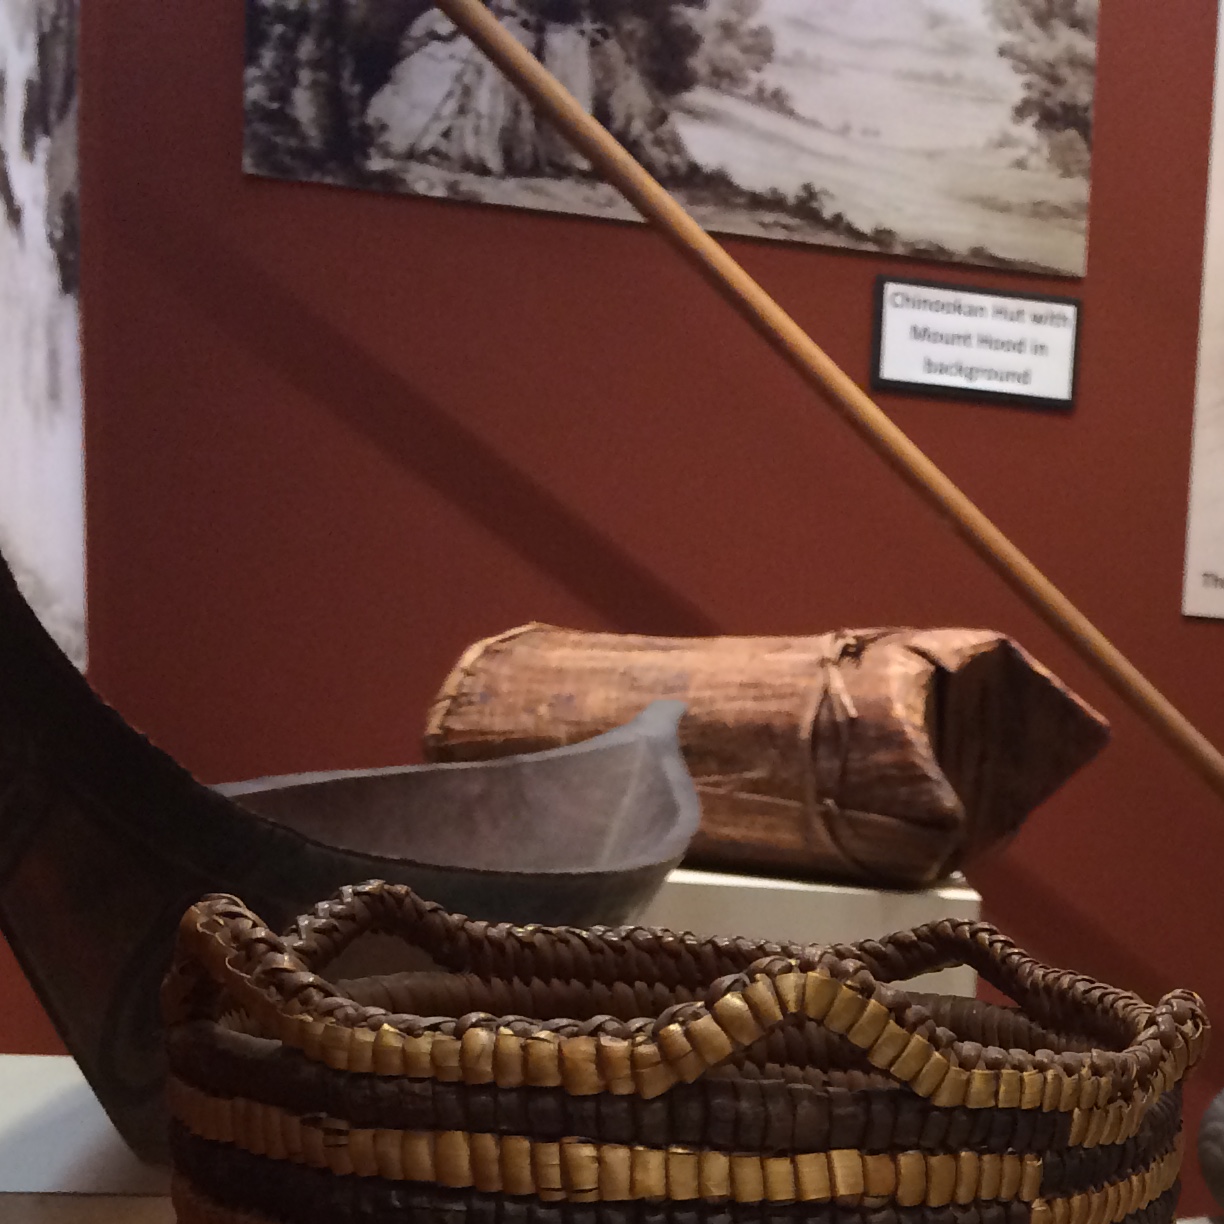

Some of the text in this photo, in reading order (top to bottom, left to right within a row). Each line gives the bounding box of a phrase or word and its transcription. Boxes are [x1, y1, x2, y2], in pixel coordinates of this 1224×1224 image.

[890, 292, 1068, 327] Chinookan Hut with
[911, 324, 1047, 355] Mount Hood in
[924, 356, 1032, 385] background
